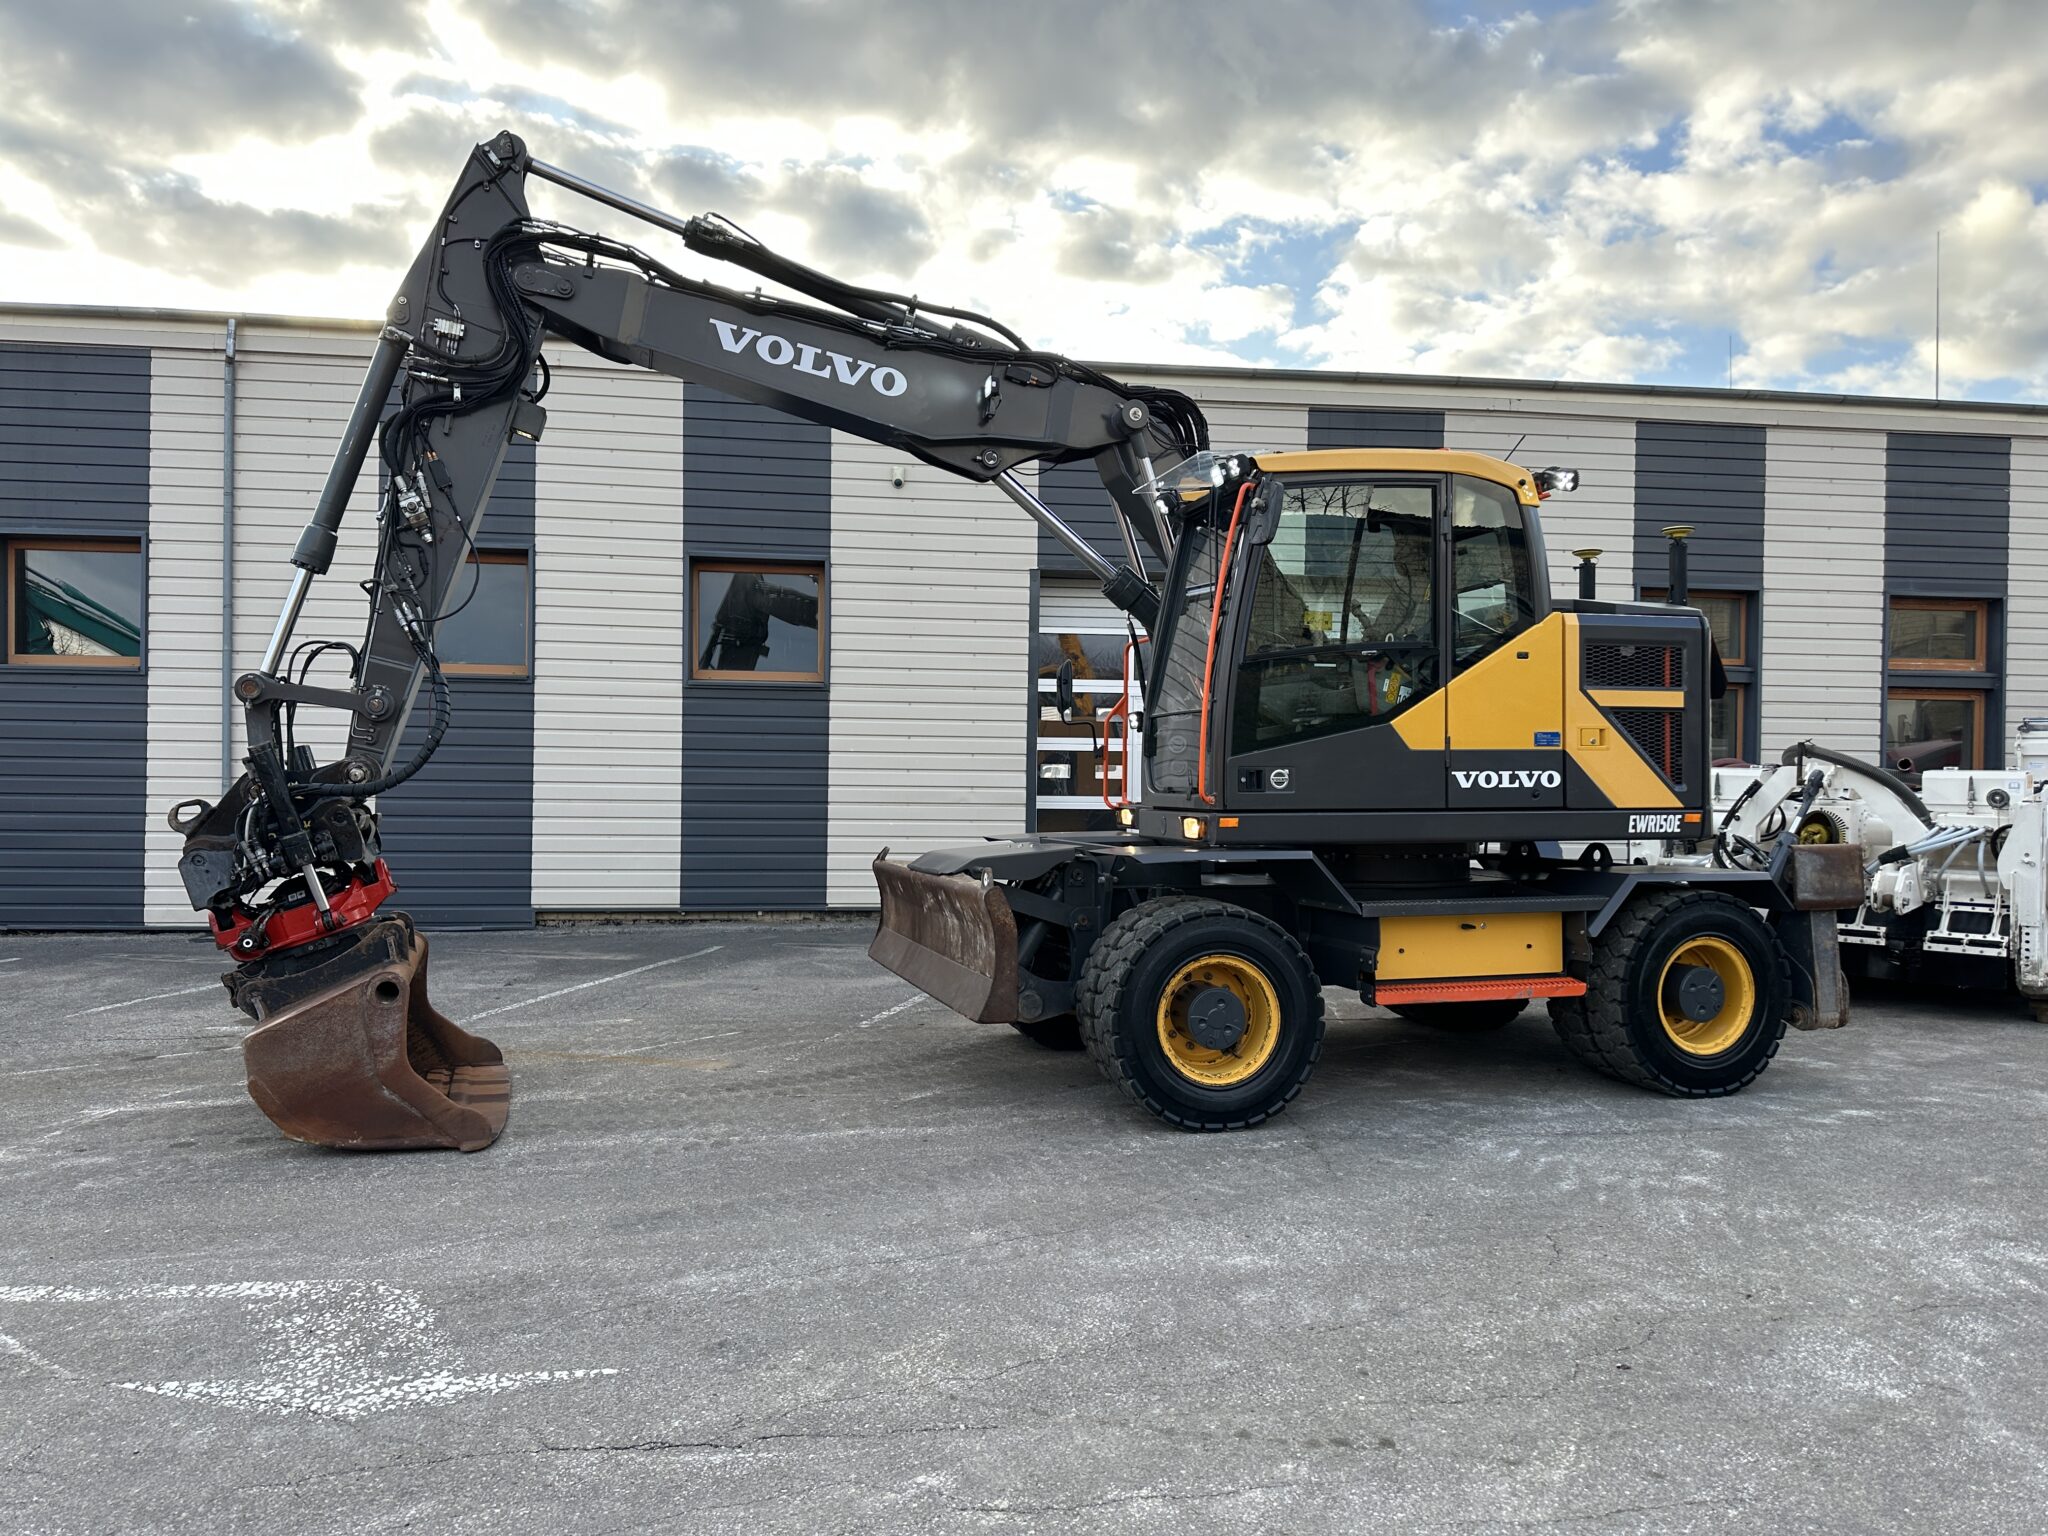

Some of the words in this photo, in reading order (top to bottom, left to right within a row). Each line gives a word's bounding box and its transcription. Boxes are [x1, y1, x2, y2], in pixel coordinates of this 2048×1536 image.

[709, 318, 908, 397] VOLVO
[1451, 770, 1561, 788] VOLVO
[1628, 814, 1682, 833] EWR150E
